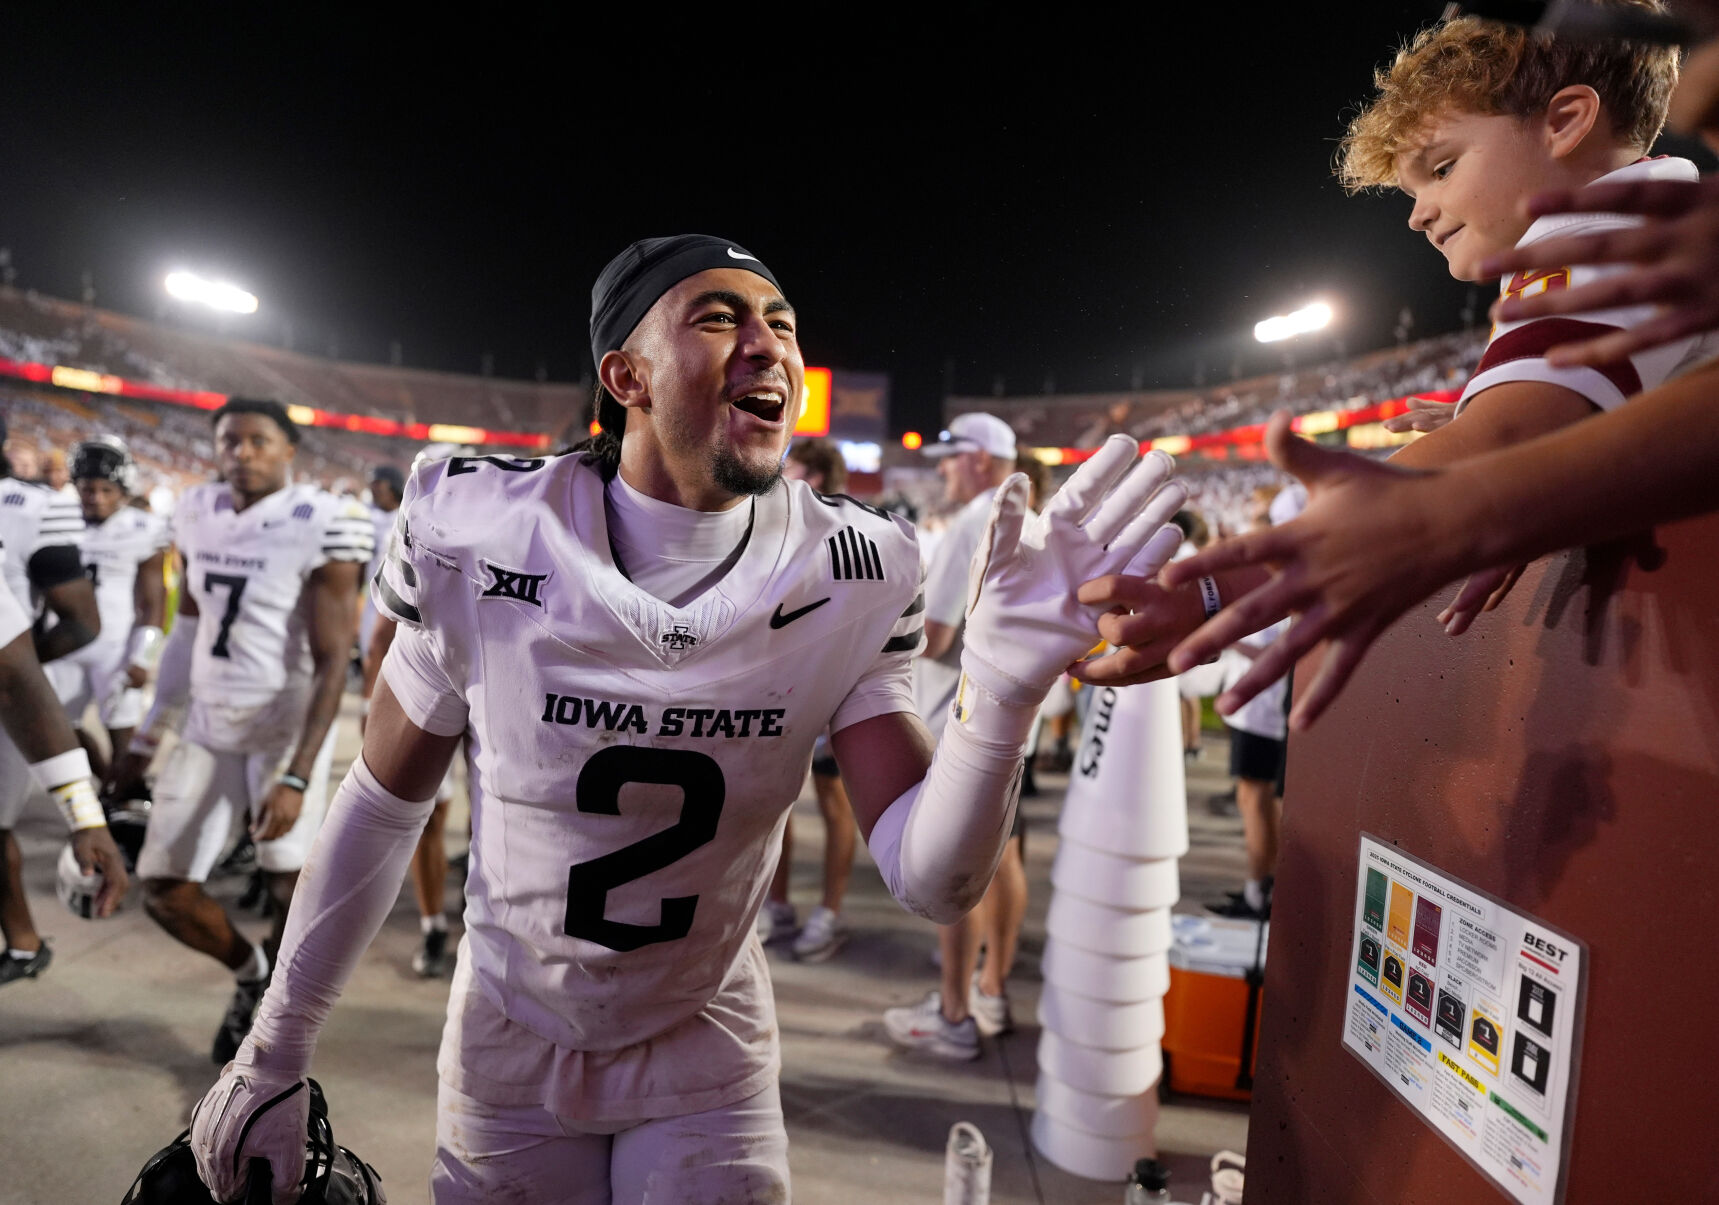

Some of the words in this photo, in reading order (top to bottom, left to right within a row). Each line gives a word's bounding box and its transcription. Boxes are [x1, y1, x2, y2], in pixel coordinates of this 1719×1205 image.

[483, 564, 547, 607] XII
[204, 572, 248, 659] 7
[541, 693, 648, 735] IOWA
[659, 708, 786, 738] STATE
[564, 745, 726, 952] 2
[1402, 868, 1421, 883] CYCLONE
[1422, 880, 1445, 897] FOOTBALL
[1446, 893, 1482, 915] CREDENTIALS
[1459, 918, 1473, 929] ZONE
[1475, 927, 1496, 941] ACCESS
[1523, 932, 1568, 961] BEST
[1441, 1055, 1460, 1073] FAST
[1461, 1068, 1479, 1088] PASS
